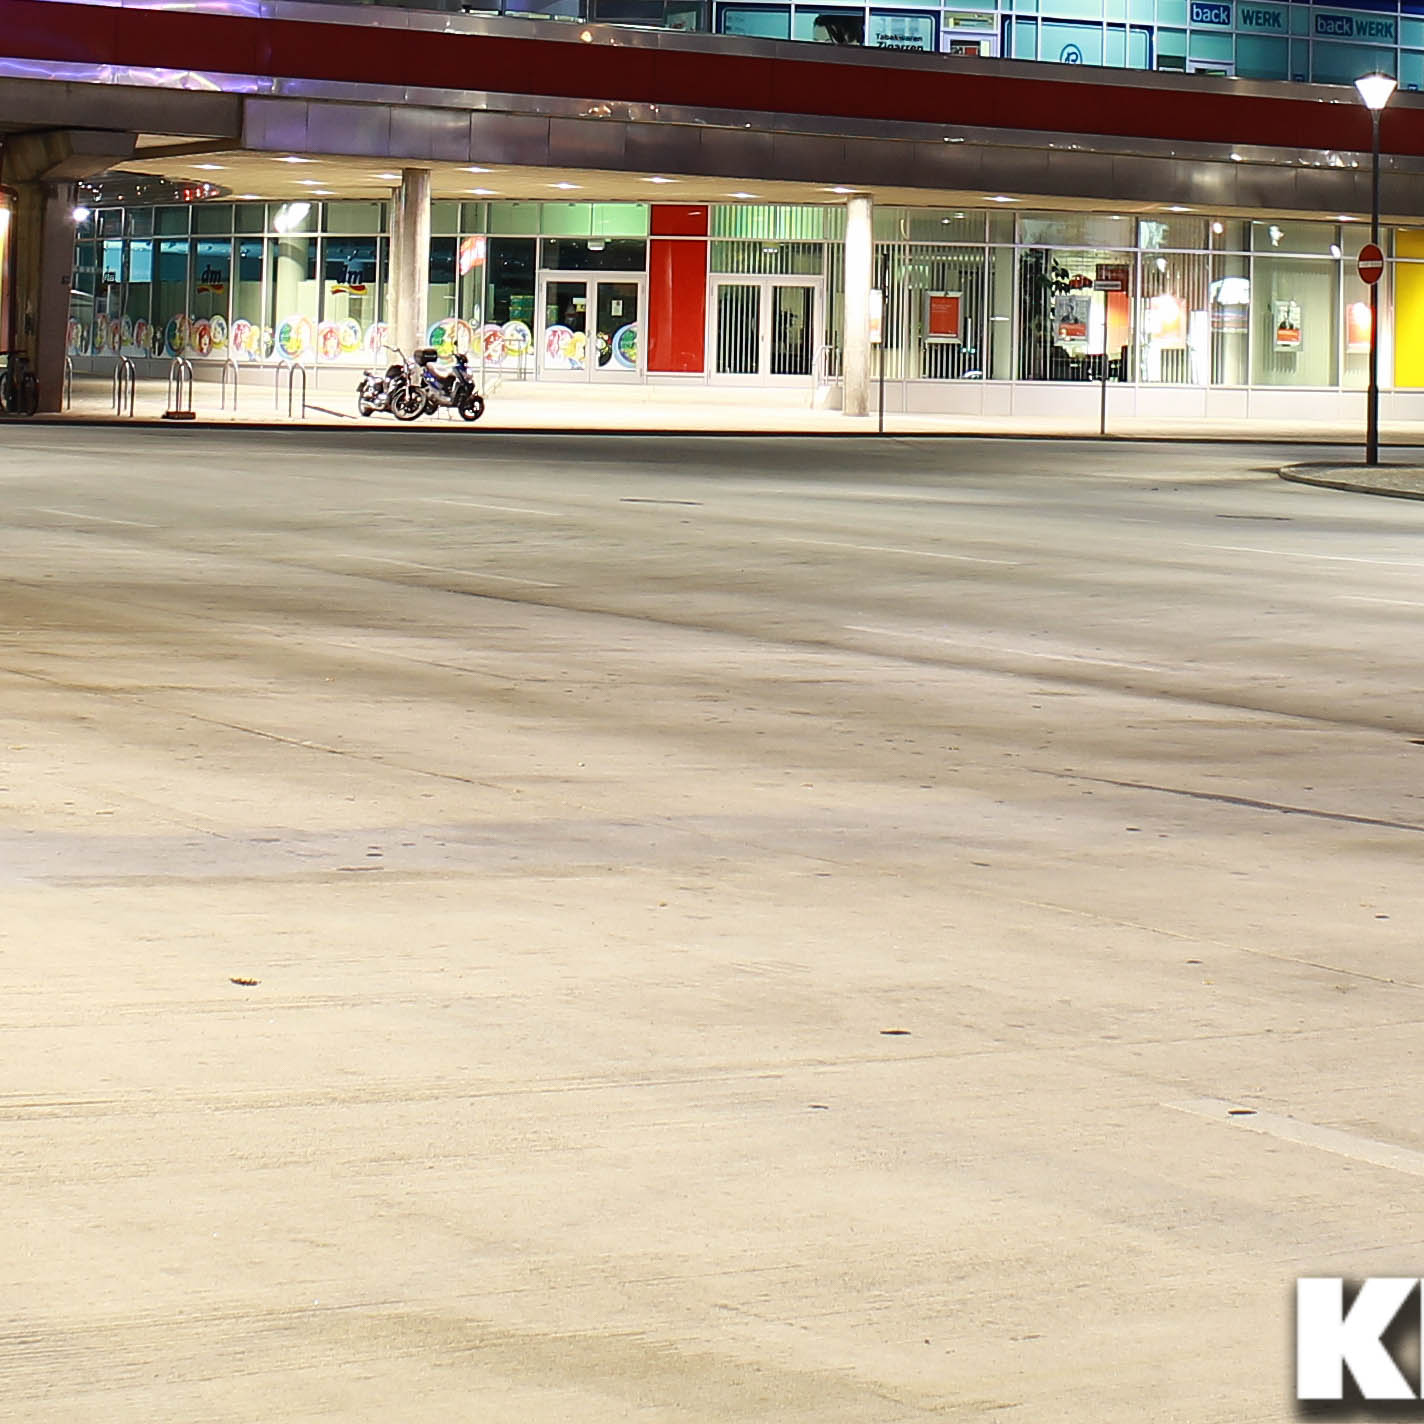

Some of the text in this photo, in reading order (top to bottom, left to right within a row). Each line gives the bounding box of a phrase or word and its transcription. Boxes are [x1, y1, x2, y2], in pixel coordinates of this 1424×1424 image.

[1192, 5, 1282, 28] back WERK
[1316, 17, 1394, 39] back WERK
